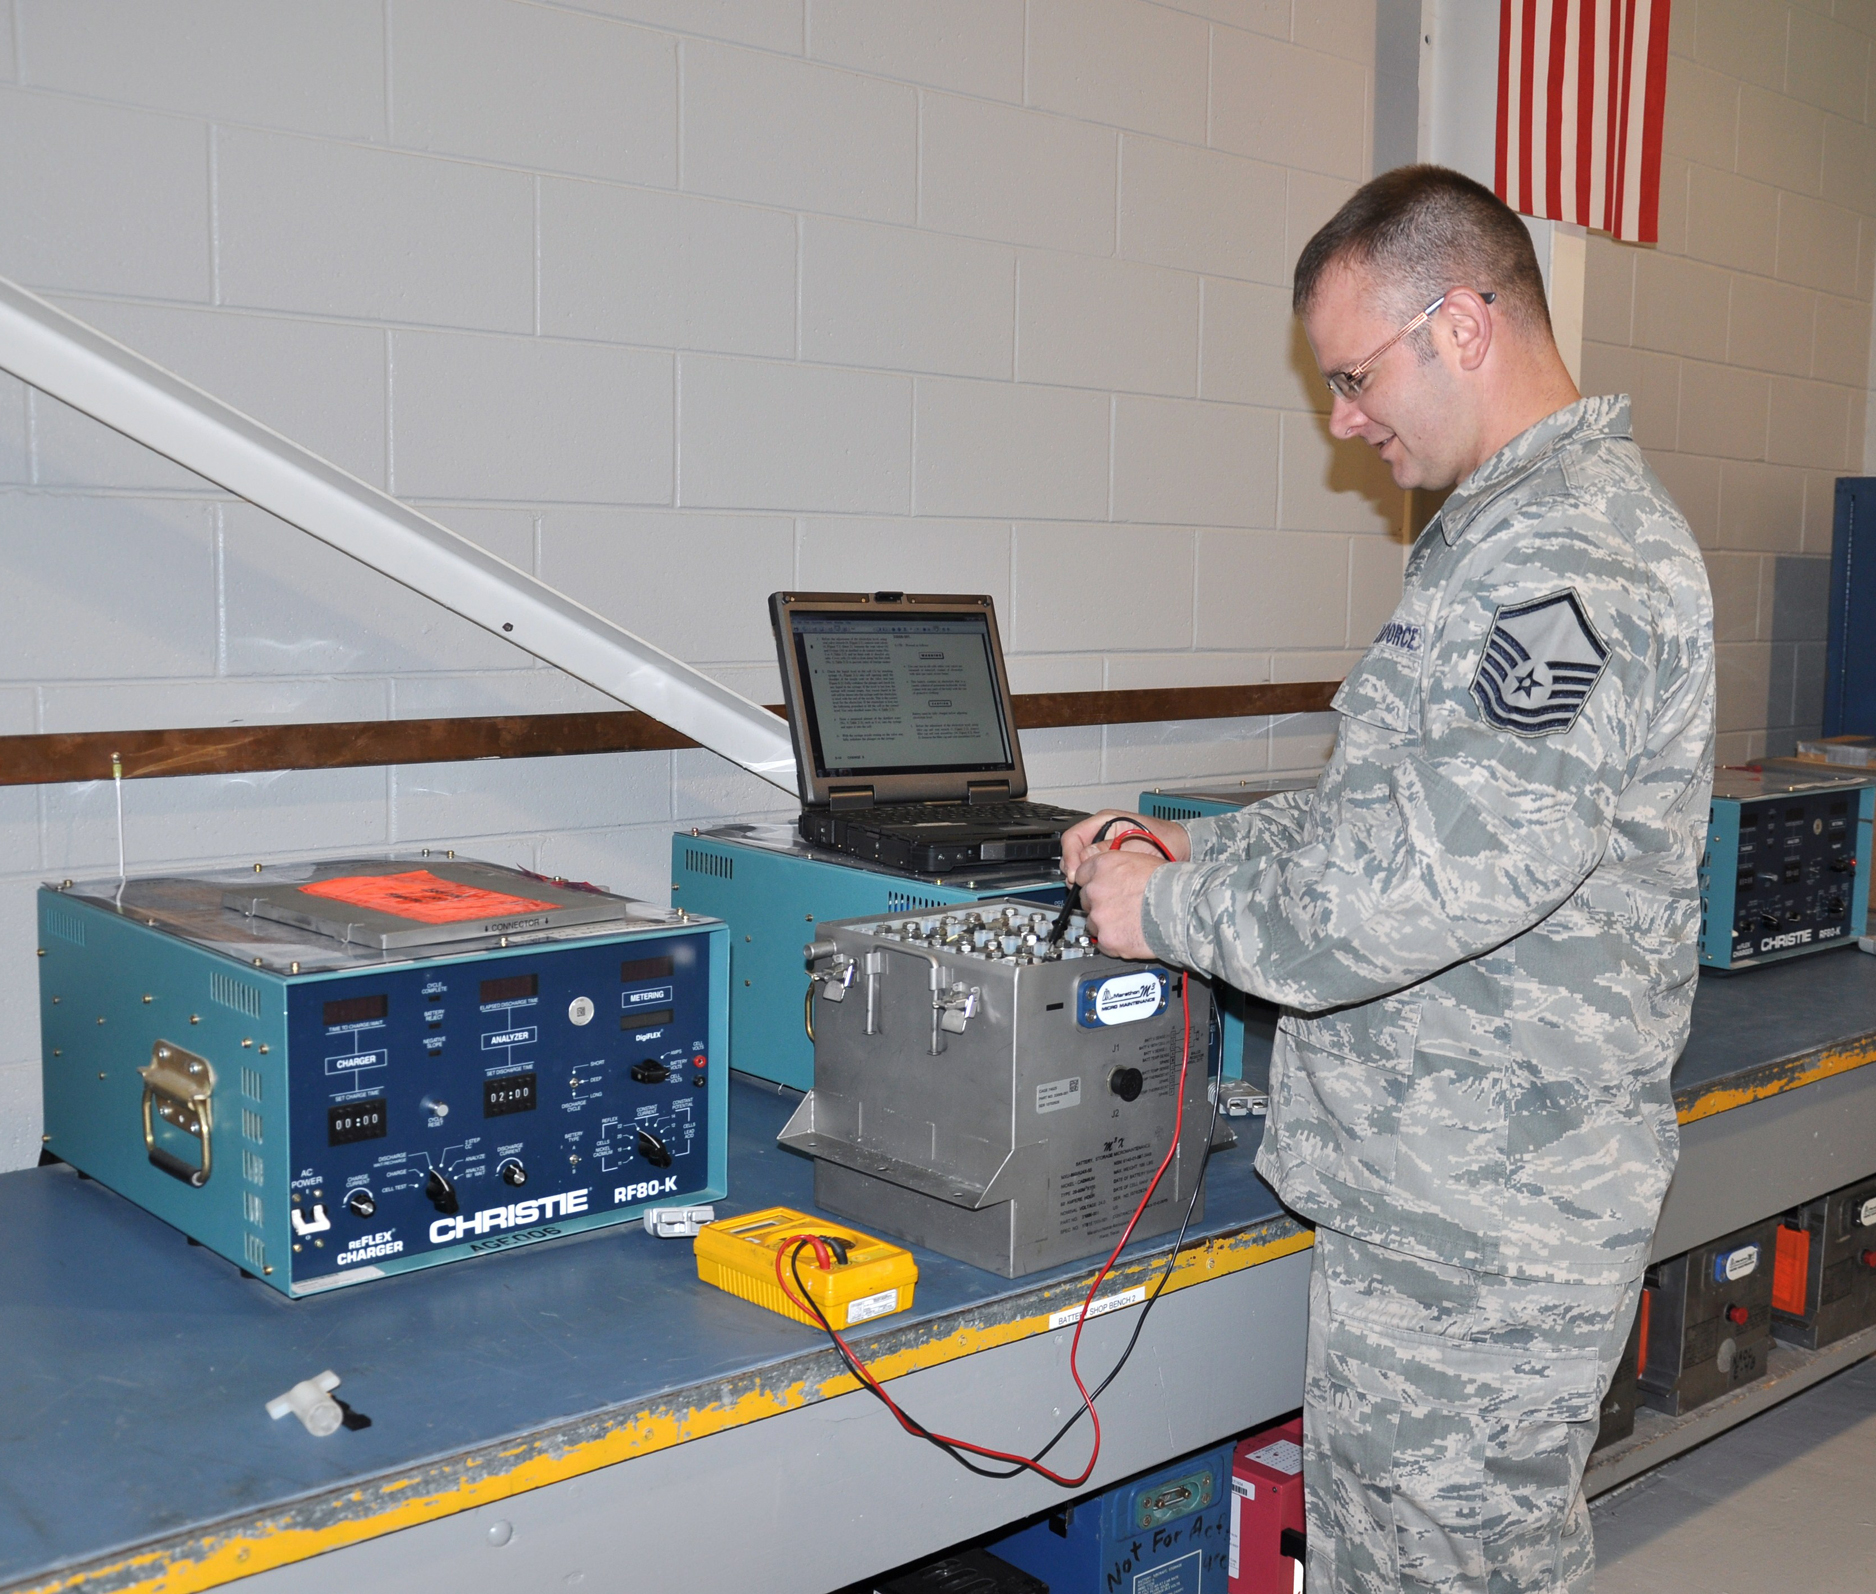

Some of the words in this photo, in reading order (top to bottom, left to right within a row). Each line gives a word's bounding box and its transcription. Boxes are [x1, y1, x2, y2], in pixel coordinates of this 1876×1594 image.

[491, 919, 540, 932] CONNECTOR
[1760, 929, 1813, 952] CHRISTIE
[421, 986, 448, 994] COMPLETE
[1113, 989, 1140, 998] Marathon
[630, 990, 664, 1003] METERING
[1119, 997, 1156, 1008] MAINTENANCE
[423, 1009, 445, 1017] BATTERY
[422, 1036, 446, 1044] NEGATIVE
[490, 1031, 529, 1045] ANALYZER
[426, 1041, 442, 1049] SLOPE
[1112, 1043, 1120, 1053] J1
[336, 1055, 377, 1069] CHARGER
[495, 1066, 522, 1075] DISCHARGE
[335, 1094, 345, 1102] SET
[345, 1092, 367, 1100] CHARGE
[367, 1089, 380, 1098] TIME
[1111, 1109, 1119, 1118] J2
[564, 1131, 583, 1139] BATTERY
[497, 1142, 524, 1152] DISCHARGE
[499, 1148, 521, 1156] CURRENT
[300, 1168, 313, 1178] AC
[347, 1173, 368, 1183] CHARGE
[386, 1168, 407, 1178] CHARGE
[291, 1176, 323, 1189] POWER
[345, 1178, 370, 1188] CURRENT
[381, 1185, 395, 1193] CELL
[395, 1183, 407, 1191] TEST
[614, 1175, 678, 1203] RF80-K
[429, 1188, 589, 1244] CHRISTIE
[336, 1240, 404, 1266] CHARGER
[1089, 1303, 1108, 1316] SHOP
[1108, 1297, 1131, 1309] BENCH
[1131, 1294, 1136, 1302] 2
[1107, 1541, 1142, 1593] Not
[1152, 1528, 1183, 1553] For
